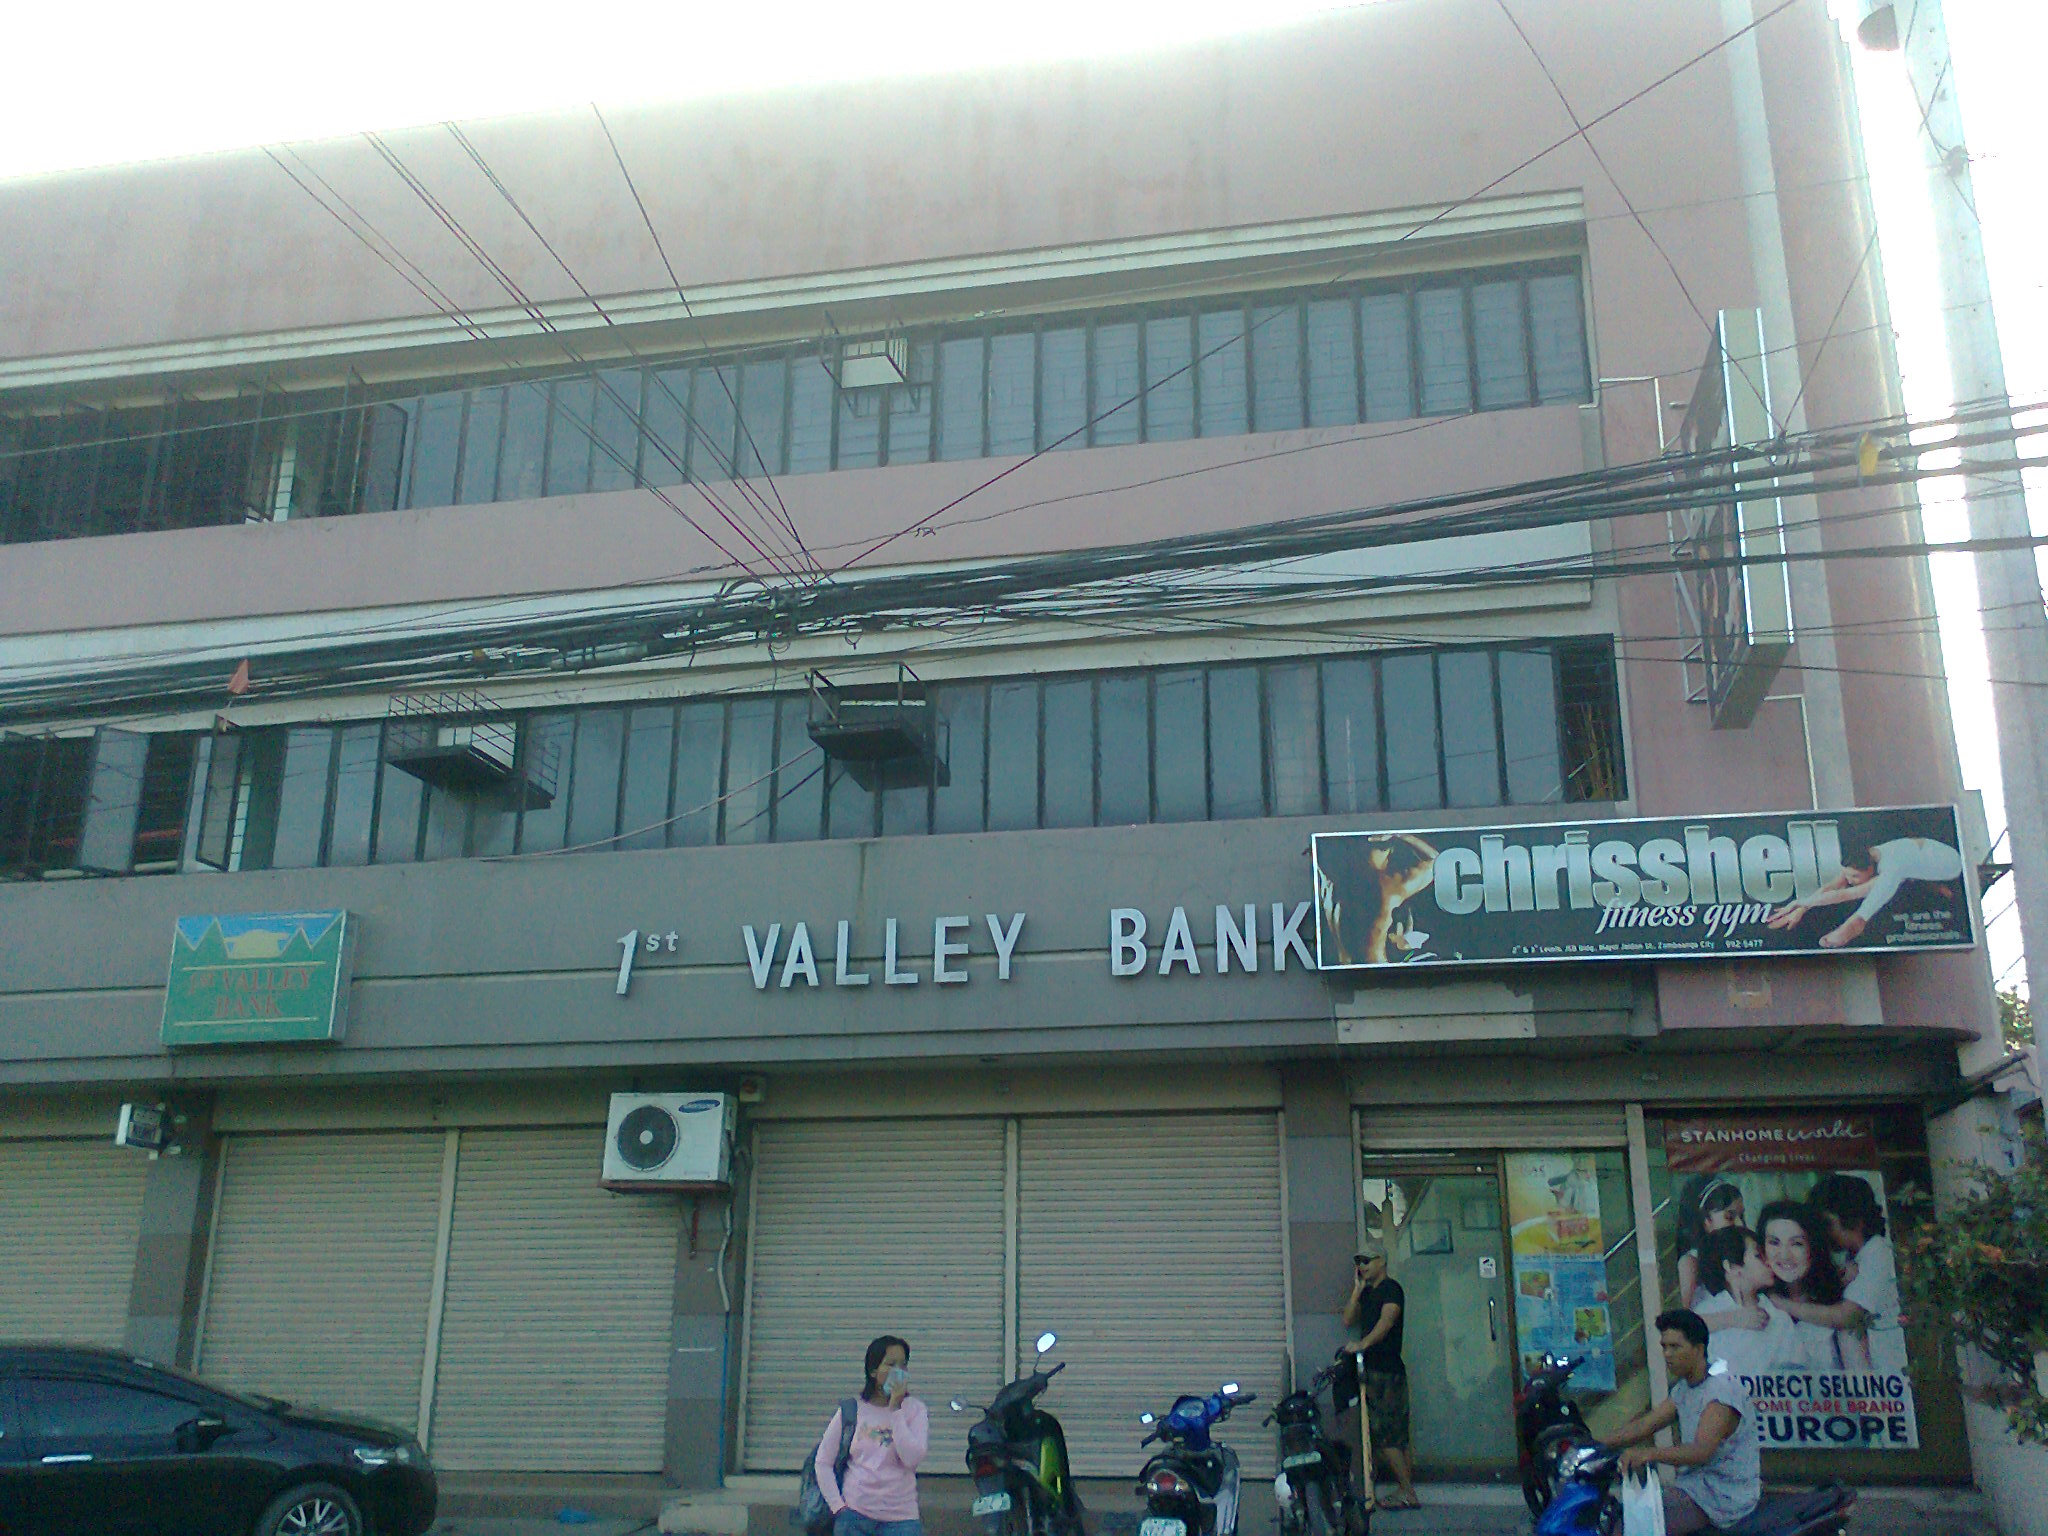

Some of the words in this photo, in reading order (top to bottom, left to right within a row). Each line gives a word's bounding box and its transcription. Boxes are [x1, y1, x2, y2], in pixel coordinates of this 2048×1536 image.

[1434, 820, 1842, 914] chrisshell
[1595, 897, 1698, 935] fitness
[1702, 902, 1772, 938] gym
[616, 929, 680, 995] 1st
[742, 912, 1026, 989] VALLEY
[1111, 901, 1317, 976] BANK
[1681, 1129, 1786, 1143] STANHOME
[1819, 1374, 1904, 1398] SELLING
[1846, 1399, 1905, 1414] BRAND
